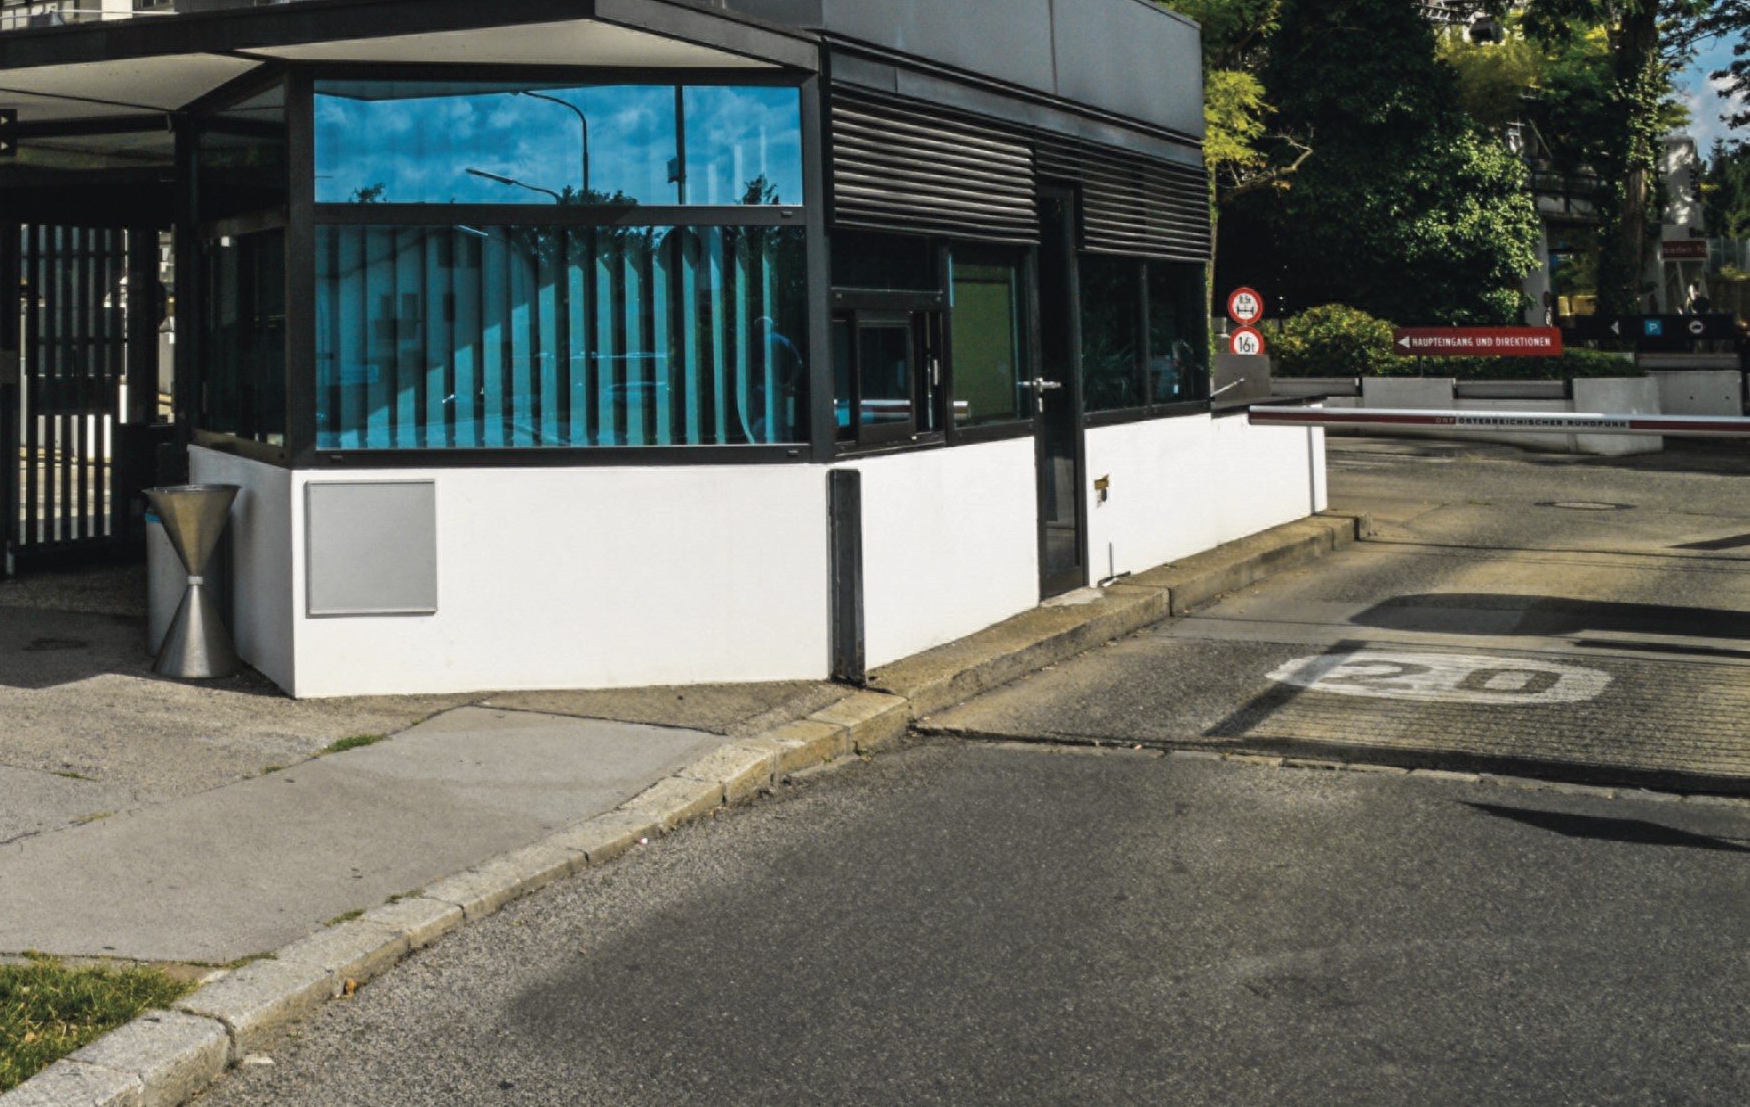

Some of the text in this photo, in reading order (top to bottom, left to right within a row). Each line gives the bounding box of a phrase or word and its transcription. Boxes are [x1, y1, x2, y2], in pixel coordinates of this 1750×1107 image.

[1412, 336, 1551, 347] HAUPTEINGANG UND DIREKTIONEN
[1567, 419, 1627, 428] RUNDFUNK
[1318, 659, 1562, 694] 20
